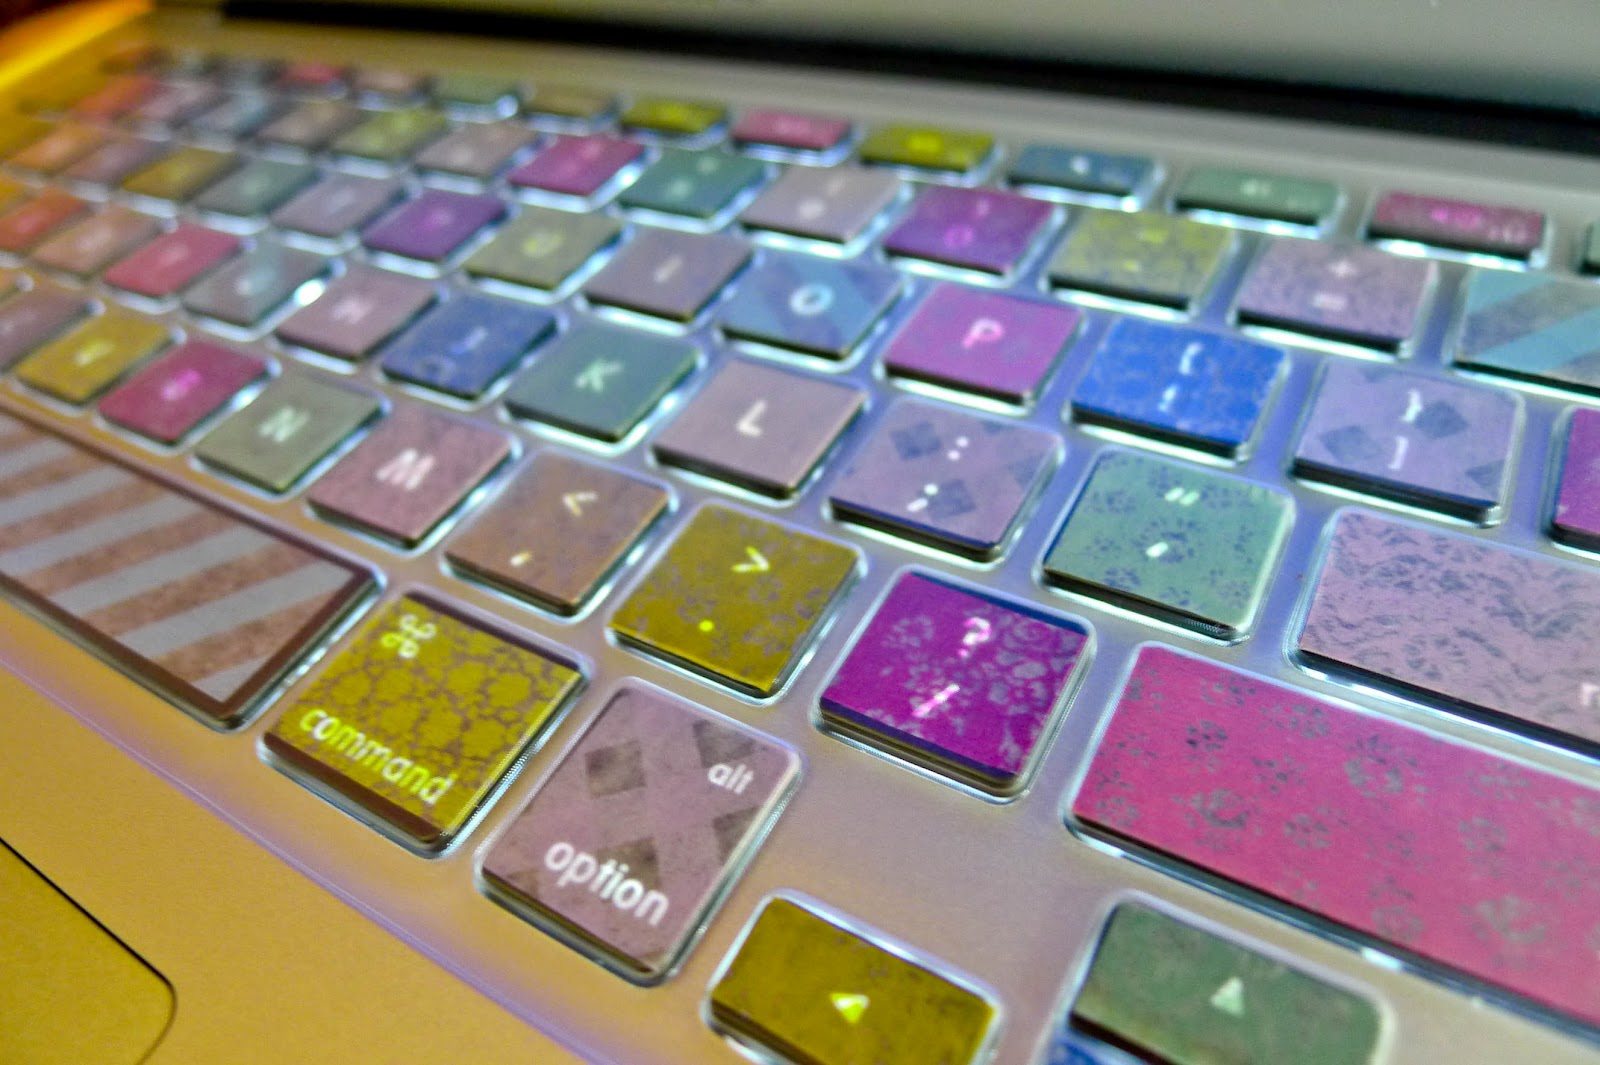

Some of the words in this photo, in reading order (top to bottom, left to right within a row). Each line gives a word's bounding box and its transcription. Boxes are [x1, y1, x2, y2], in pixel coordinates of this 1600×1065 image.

[789, 281, 837, 317] O
[961, 318, 1005, 350] P
[574, 357, 624, 393] K
[260, 404, 309, 443] N
[735, 399, 767, 438] L
[375, 448, 436, 492] M
[958, 616, 992, 659] ?
[299, 707, 458, 806] command
[707, 761, 755, 796] alt
[543, 840, 670, 928] option
